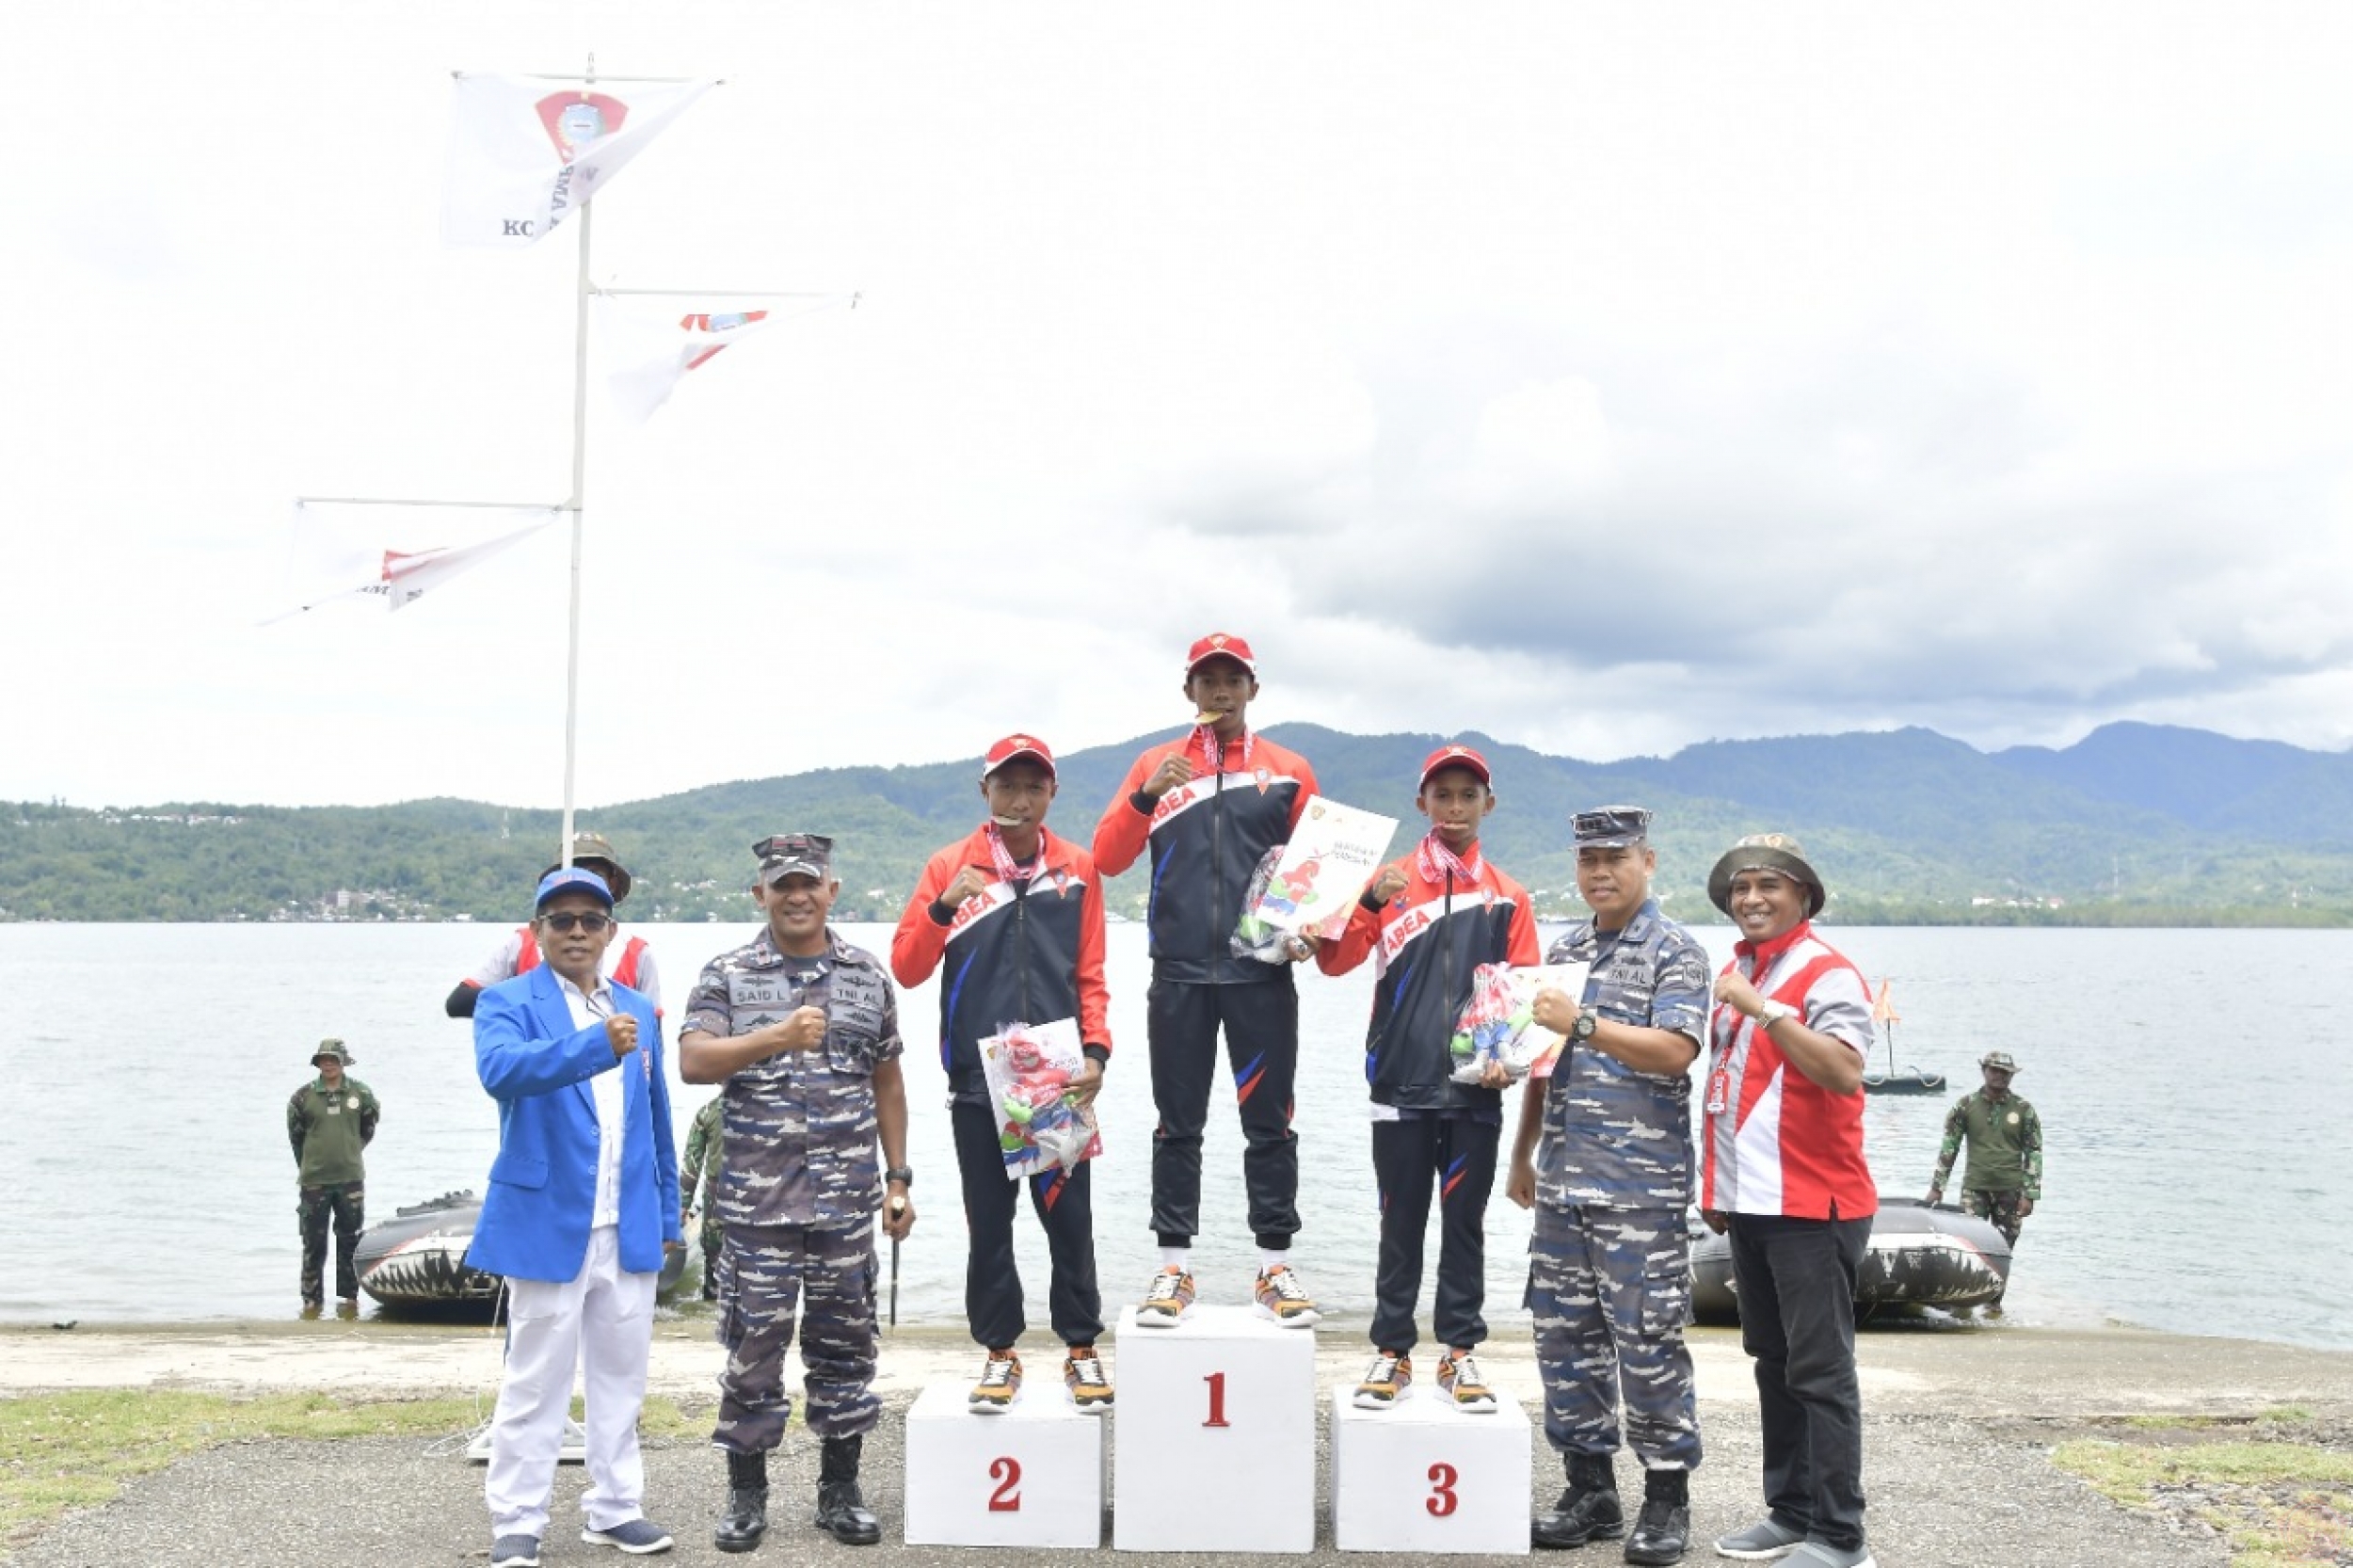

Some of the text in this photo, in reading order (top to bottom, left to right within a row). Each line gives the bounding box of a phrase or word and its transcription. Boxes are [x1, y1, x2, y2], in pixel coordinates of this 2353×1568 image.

[1150, 786, 1197, 823] BEA
[949, 890, 998, 929] BEA
[737, 988, 786, 1002] SAID L
[836, 988, 858, 1000] TNI
[1202, 1371, 1230, 1428] 1
[988, 1457, 1021, 1512] 2
[1426, 1463, 1458, 1517] 3
